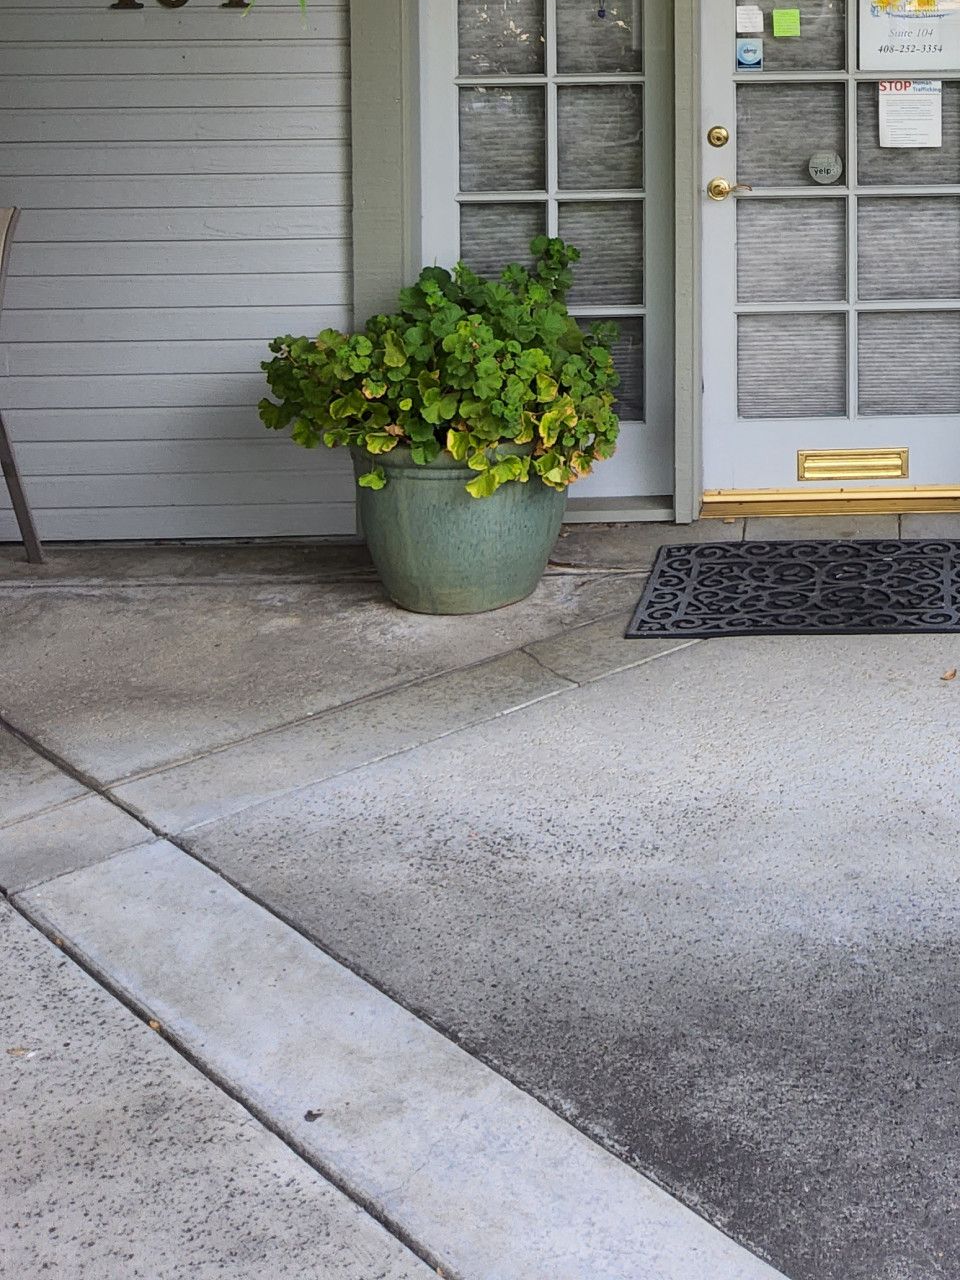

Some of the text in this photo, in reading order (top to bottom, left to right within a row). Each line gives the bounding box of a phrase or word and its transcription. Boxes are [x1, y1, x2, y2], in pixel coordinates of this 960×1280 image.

[888, 29, 933, 37] Suite 104
[878, 45, 943, 53] 408-252-3354
[879, 81, 911, 91] STOP
[814, 167, 831, 176] yelp
